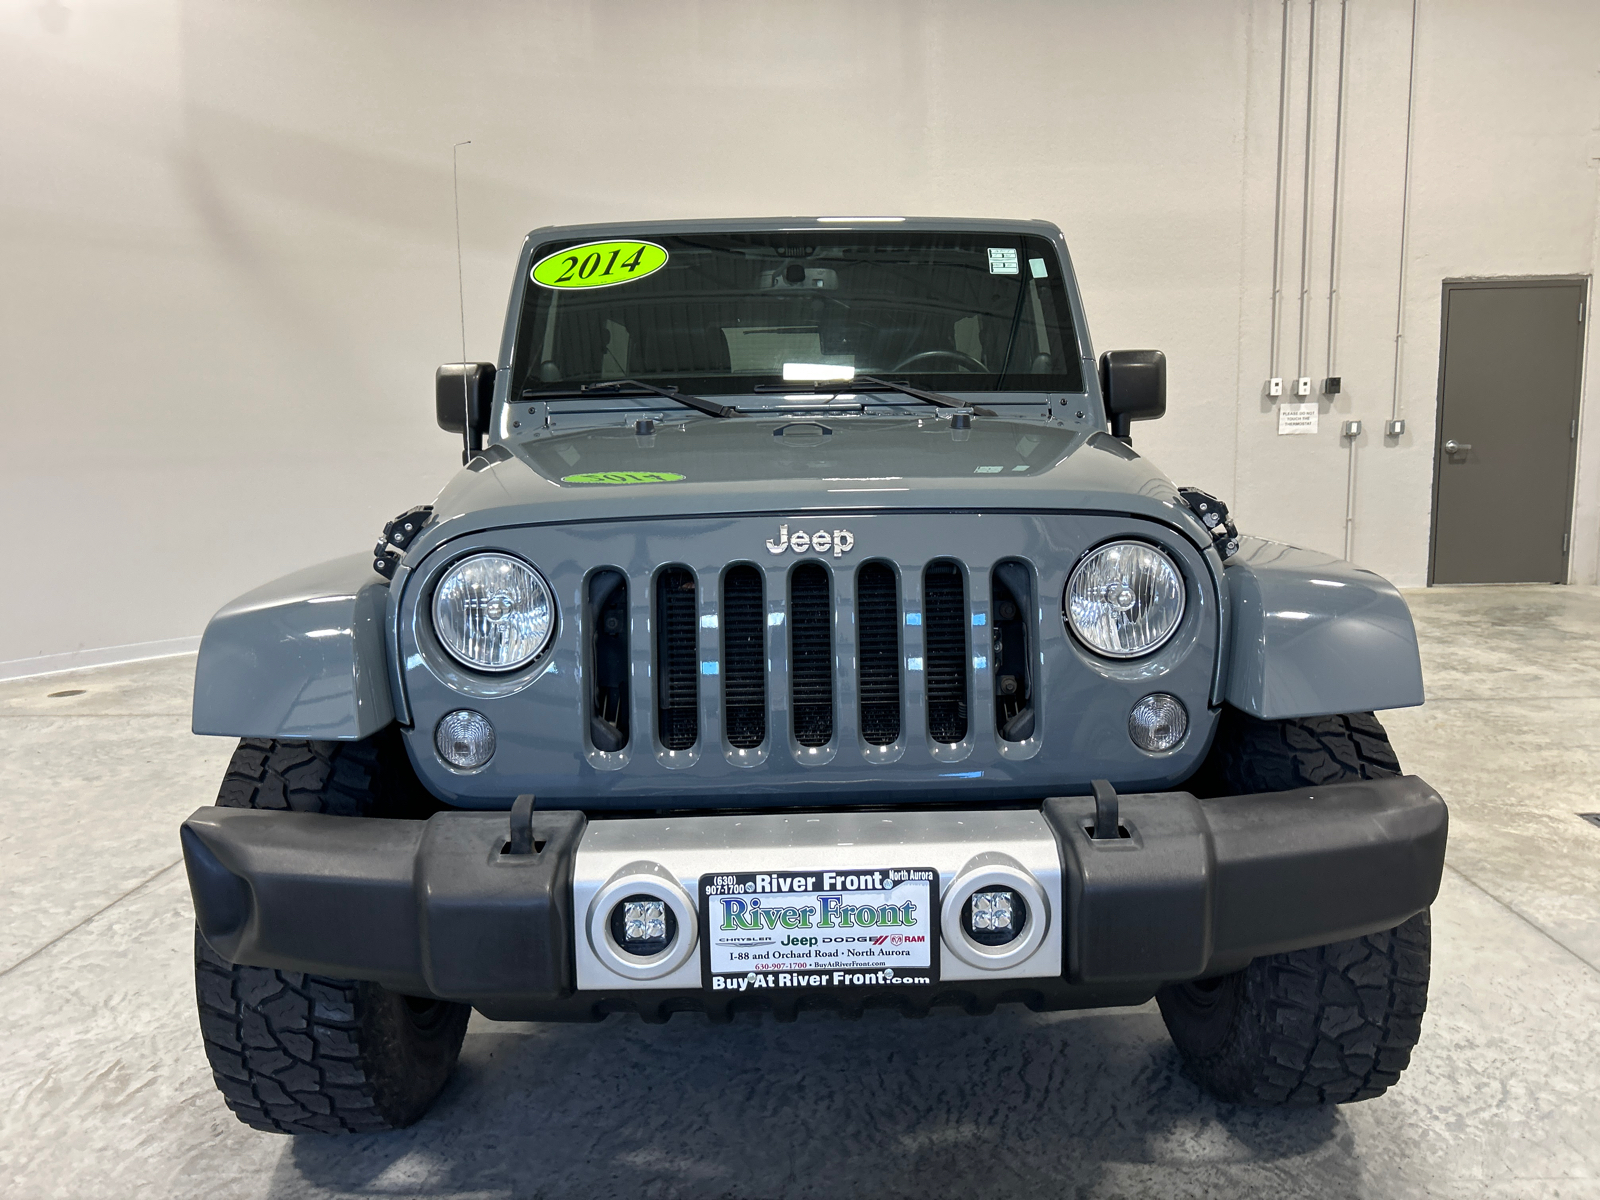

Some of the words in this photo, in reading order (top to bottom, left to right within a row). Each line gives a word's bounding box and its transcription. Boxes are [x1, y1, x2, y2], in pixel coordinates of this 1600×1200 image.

[553, 245, 647, 283] 2014
[765, 523, 855, 557] Jeep
[713, 875, 737, 886] (630)
[889, 869, 908, 880] North
[909, 869, 933, 880] Aurora
[755, 874, 816, 892] River
[823, 871, 882, 890] Front
[705, 884, 745, 895] 907-1700
[720, 897, 816, 930] River
[817, 894, 917, 928] Front
[780, 934, 818, 947] Jeep
[904, 935, 925, 943] RAM
[729, 951, 750, 961] I-88
[752, 950, 770, 960] and
[772, 949, 812, 959] Orchard
[814, 948, 839, 958] Road
[847, 948, 875, 957] North
[877, 948, 910, 957] Aurora
[754, 961, 807, 970] 630-907-1700
[814, 960, 886, 969] BuyAtRiverFront.com
[712, 975, 748, 991] Buy
[753, 973, 775, 988] At
[778, 972, 829, 987] River
